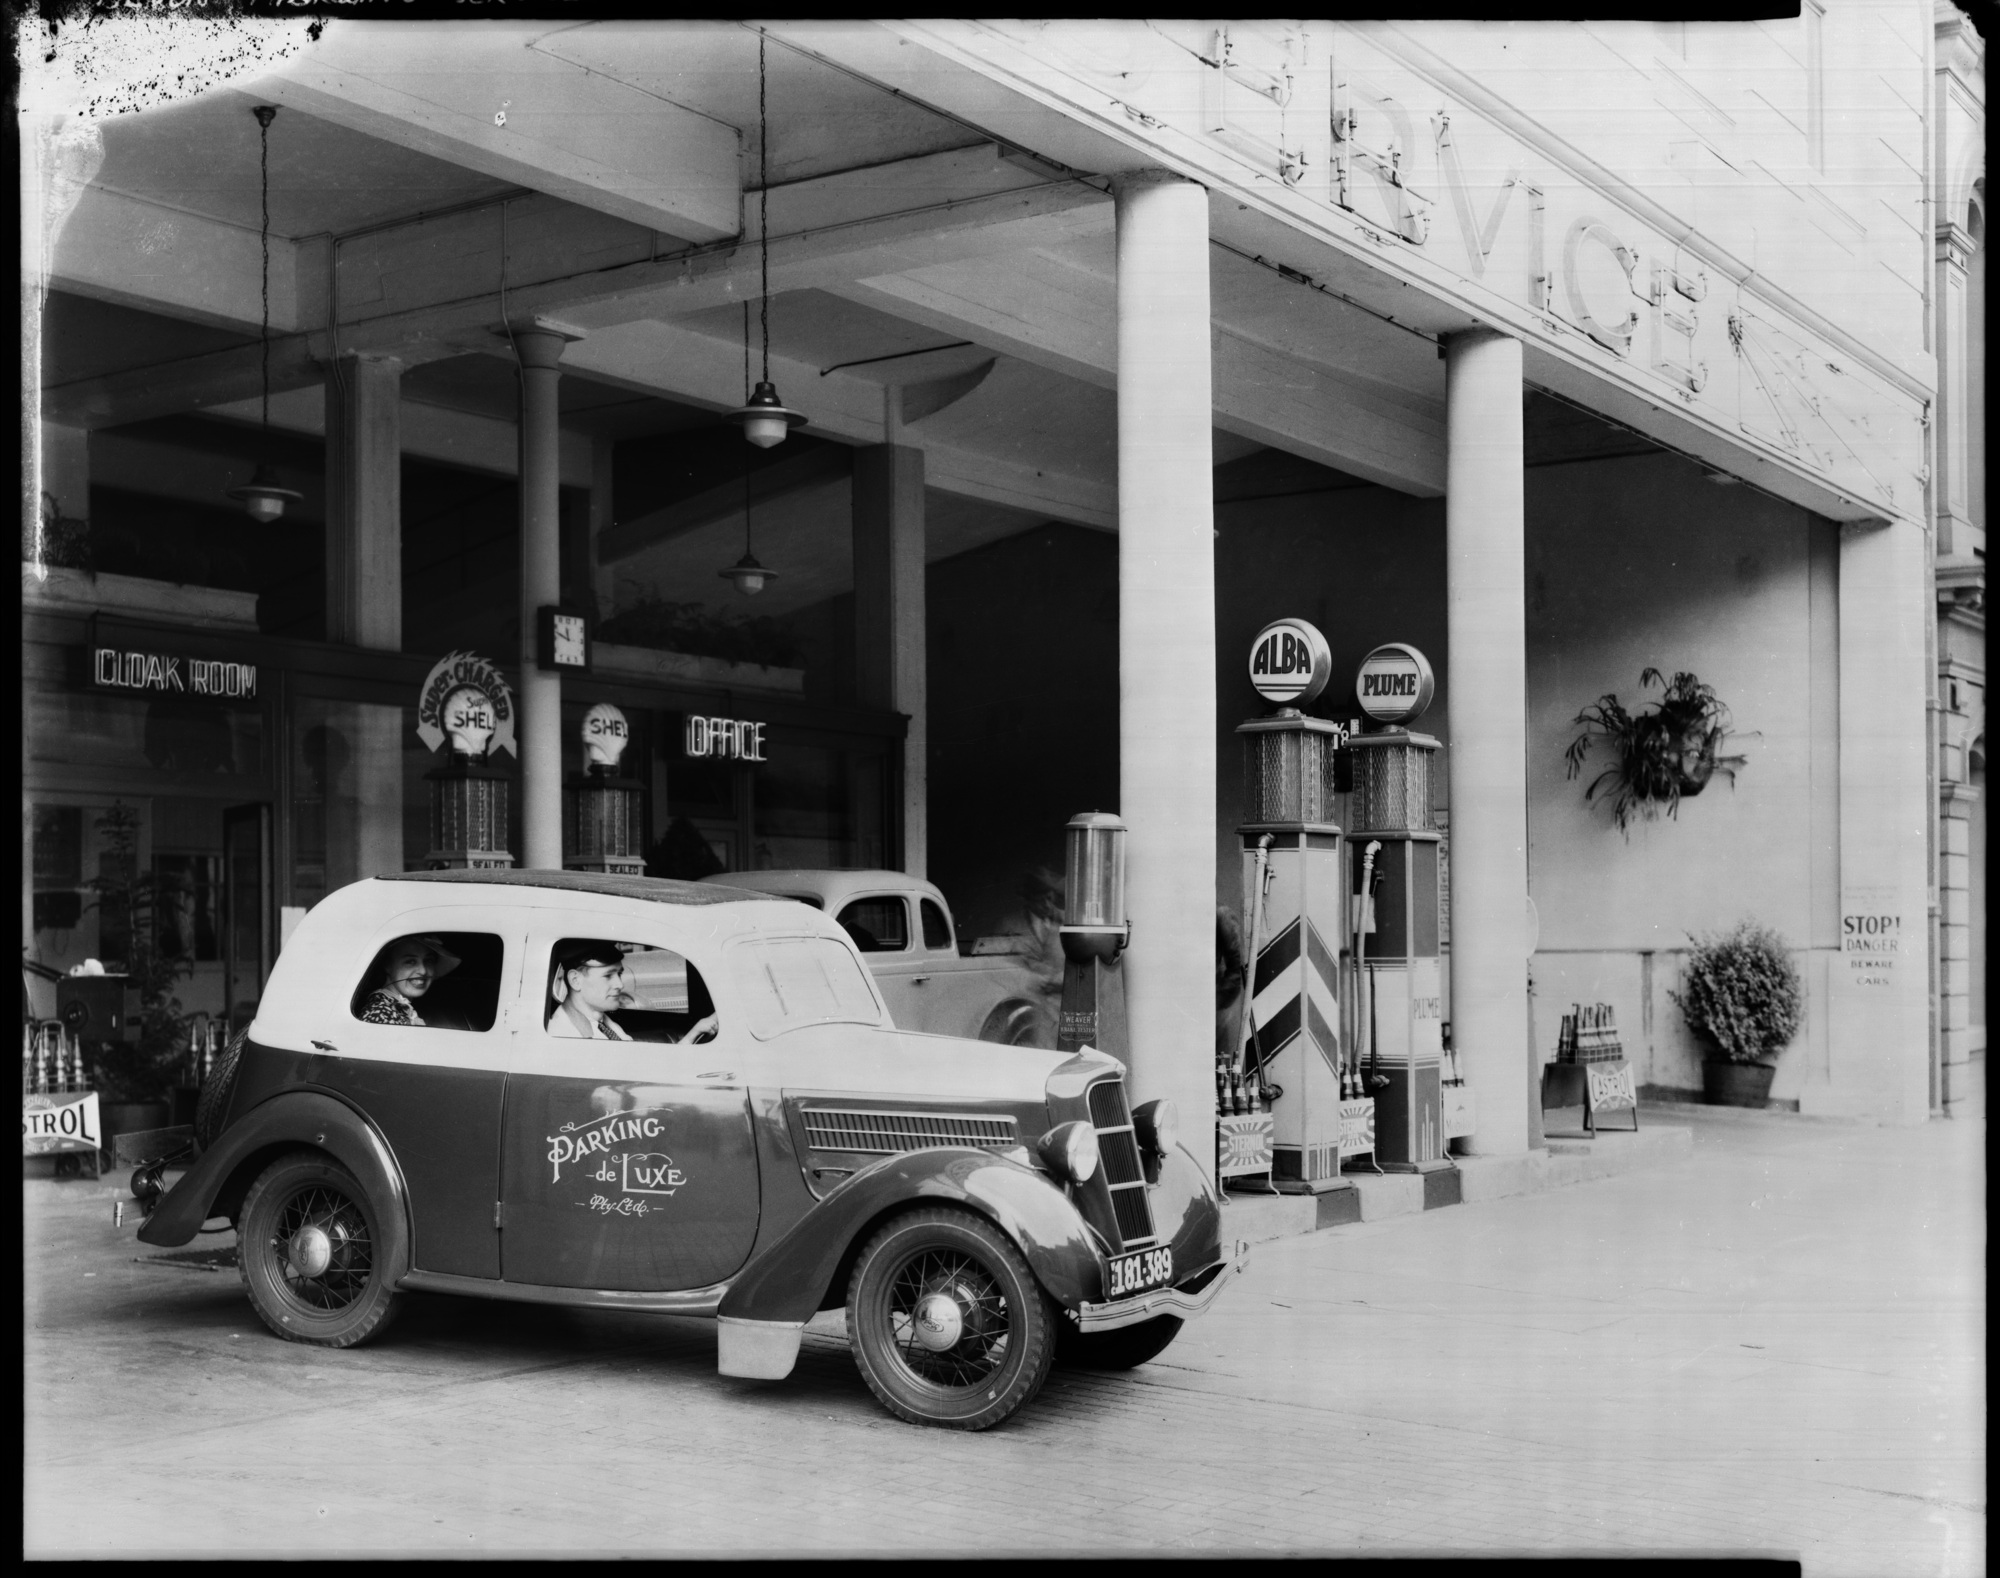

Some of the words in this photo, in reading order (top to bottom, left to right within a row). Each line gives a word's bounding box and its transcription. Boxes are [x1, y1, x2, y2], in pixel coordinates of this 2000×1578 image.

[1253, 632, 1311, 675] ALBA
[96, 649, 184, 692] CLOAK
[189, 659, 257, 697] ROOM
[1362, 673, 1417, 697] PLUME
[686, 715, 768, 761] OFFICE
[609, 866, 639, 875] SEALED
[1843, 915, 1901, 936] STOP!
[1846, 938, 1899, 952] DANGER
[1850, 960, 1893, 969] BEWARE
[1065, 1015, 1091, 1024] WEAVER
[1413, 998, 1440, 1020] PLUME
[1592, 1070, 1634, 1103] CASTROL
[546, 1117, 666, 1185] PARKING
[1228, 1133, 1265, 1153] STERNOL
[595, 1160, 617, 1182] de
